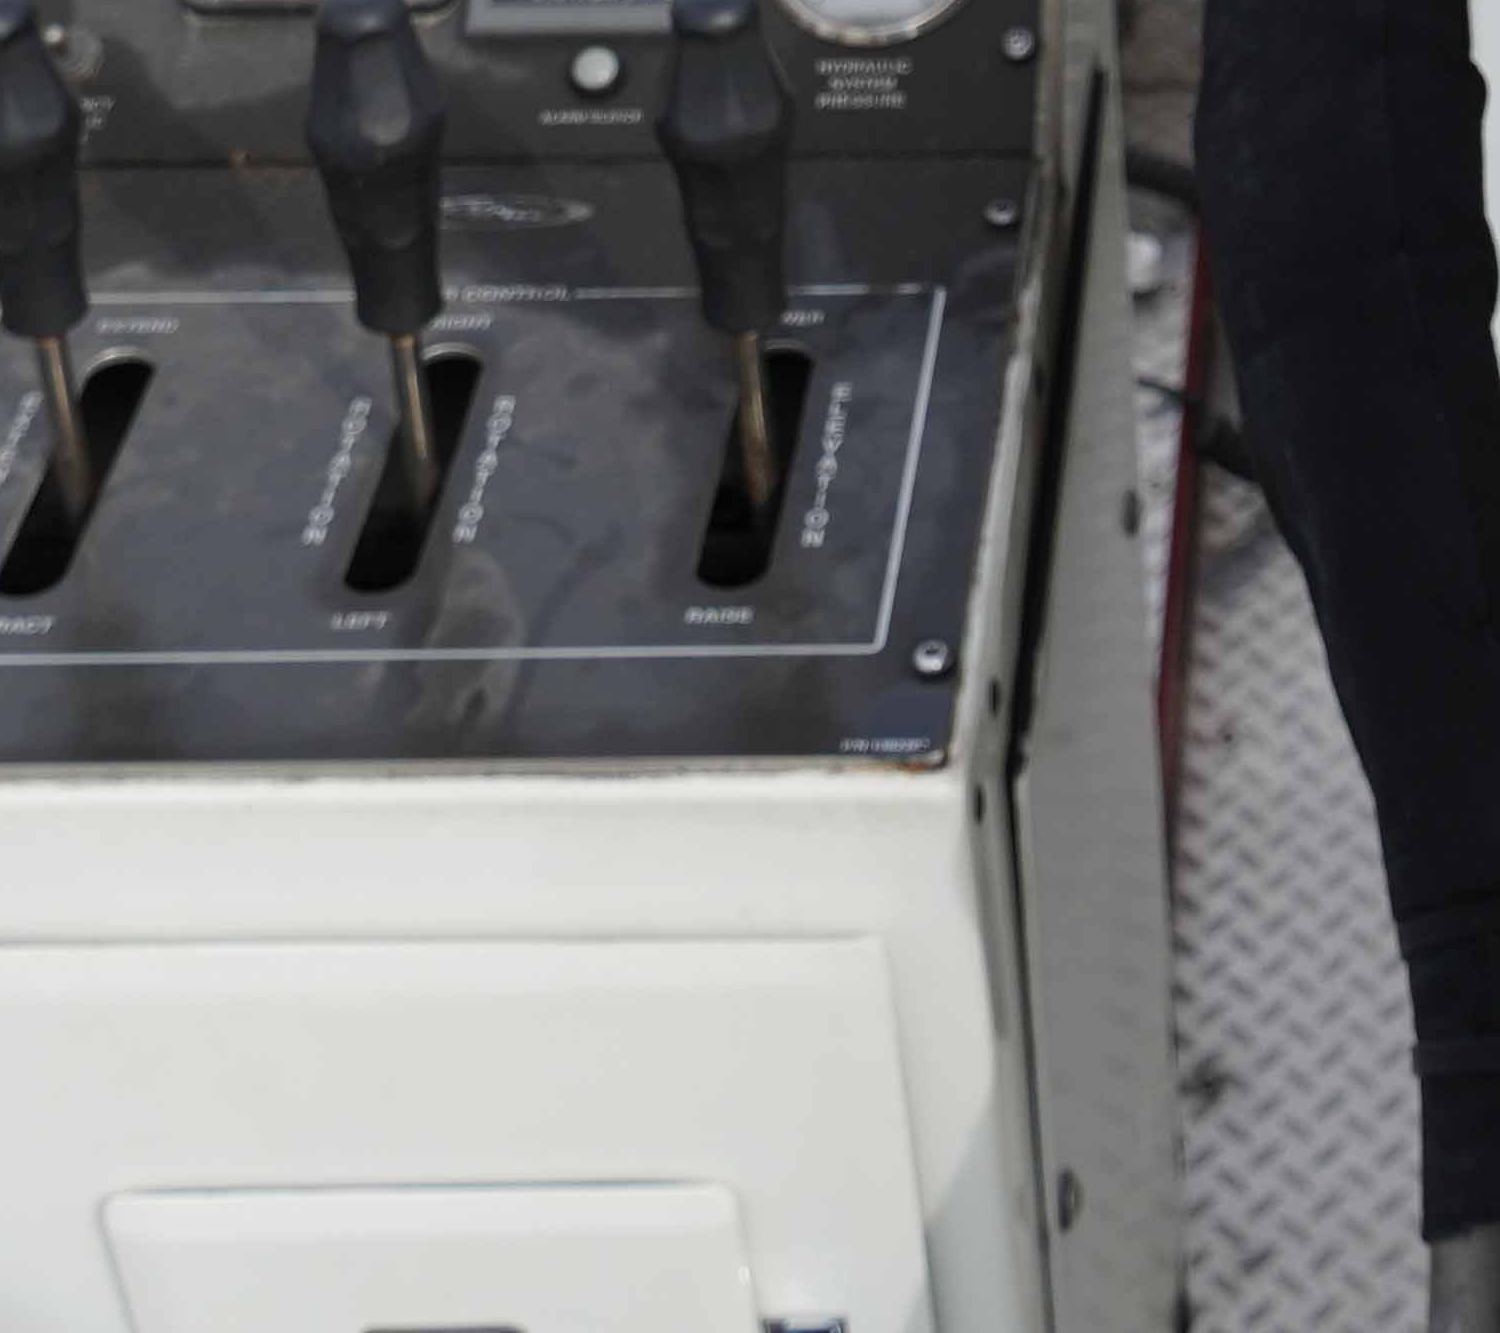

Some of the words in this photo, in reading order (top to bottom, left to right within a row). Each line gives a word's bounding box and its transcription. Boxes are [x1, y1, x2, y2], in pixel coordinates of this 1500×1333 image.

[303, 397, 372, 546] ROTATION
[453, 394, 515, 544] ROTATION
[802, 382, 851, 547] ELEVATION
[330, 612, 390, 630] LEFT
[684, 606, 754, 624] RAISE
